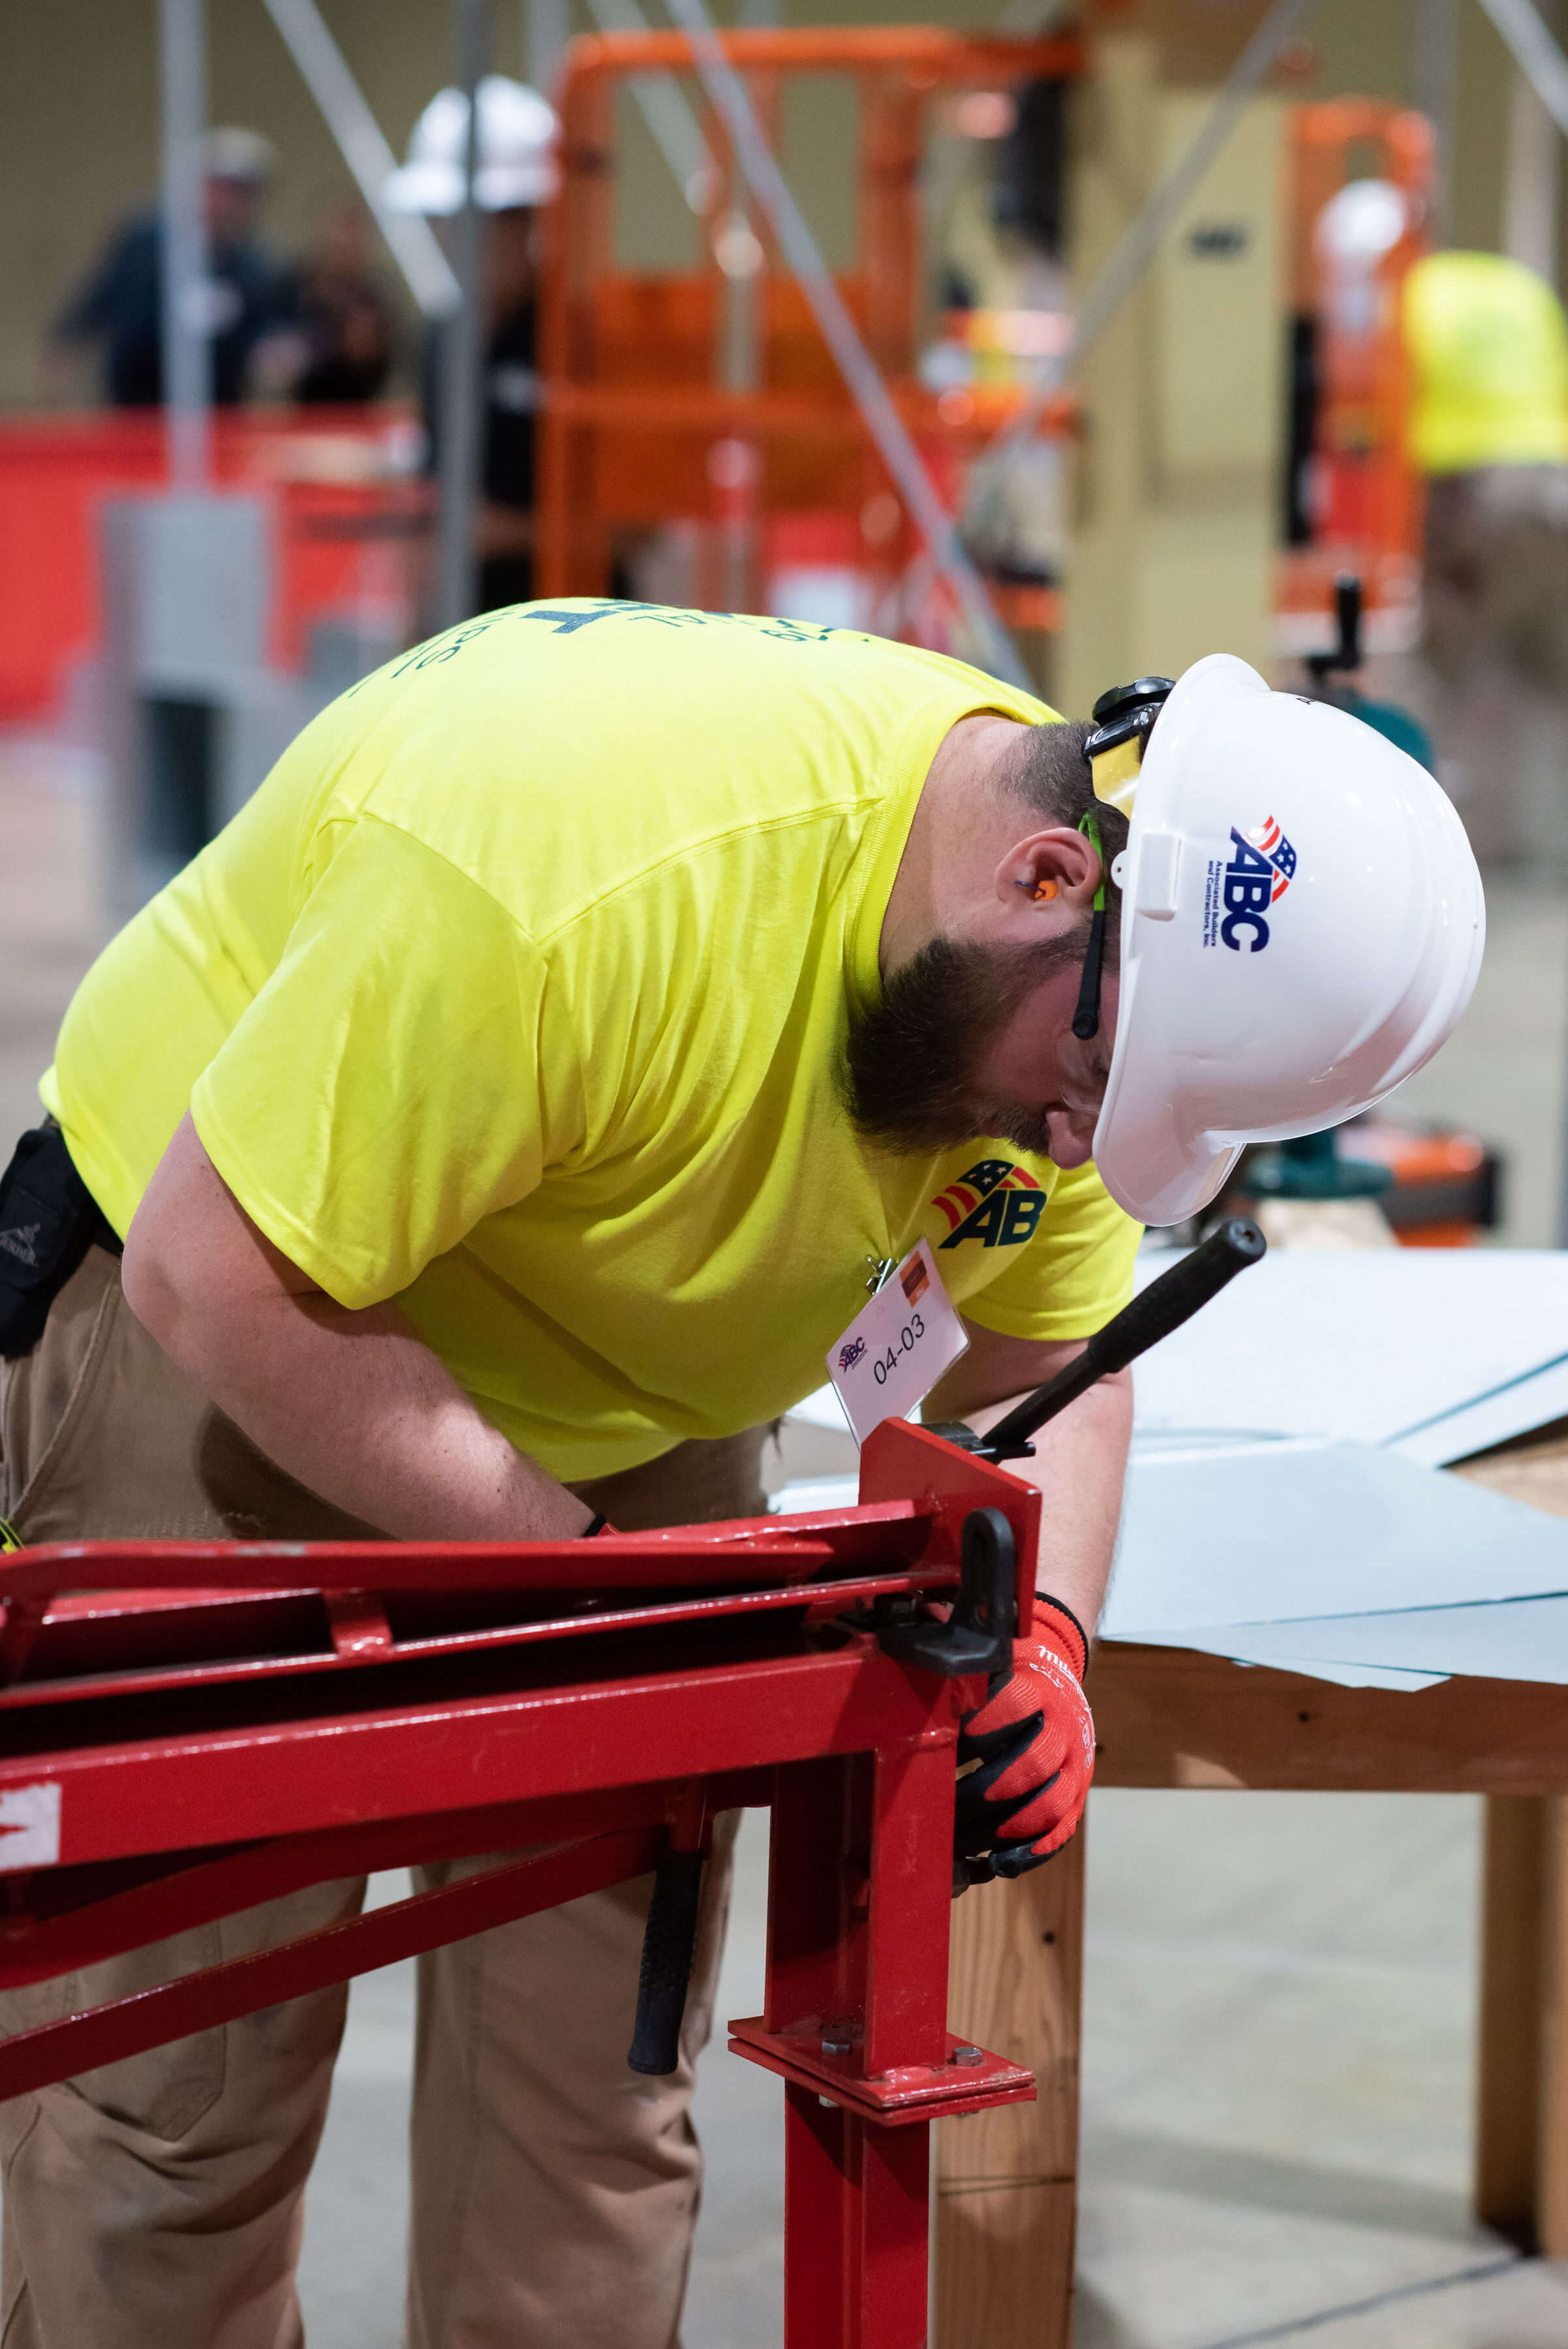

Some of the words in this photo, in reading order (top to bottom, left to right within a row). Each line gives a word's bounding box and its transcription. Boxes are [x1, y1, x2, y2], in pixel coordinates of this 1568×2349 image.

[1204, 877, 1214, 930] Contractors,
[1212, 861, 1222, 909] Associated
[1221, 826, 1273, 953] ABC
[844, 1336, 865, 1373] ABC
[873, 1313, 925, 1385] 04-03
